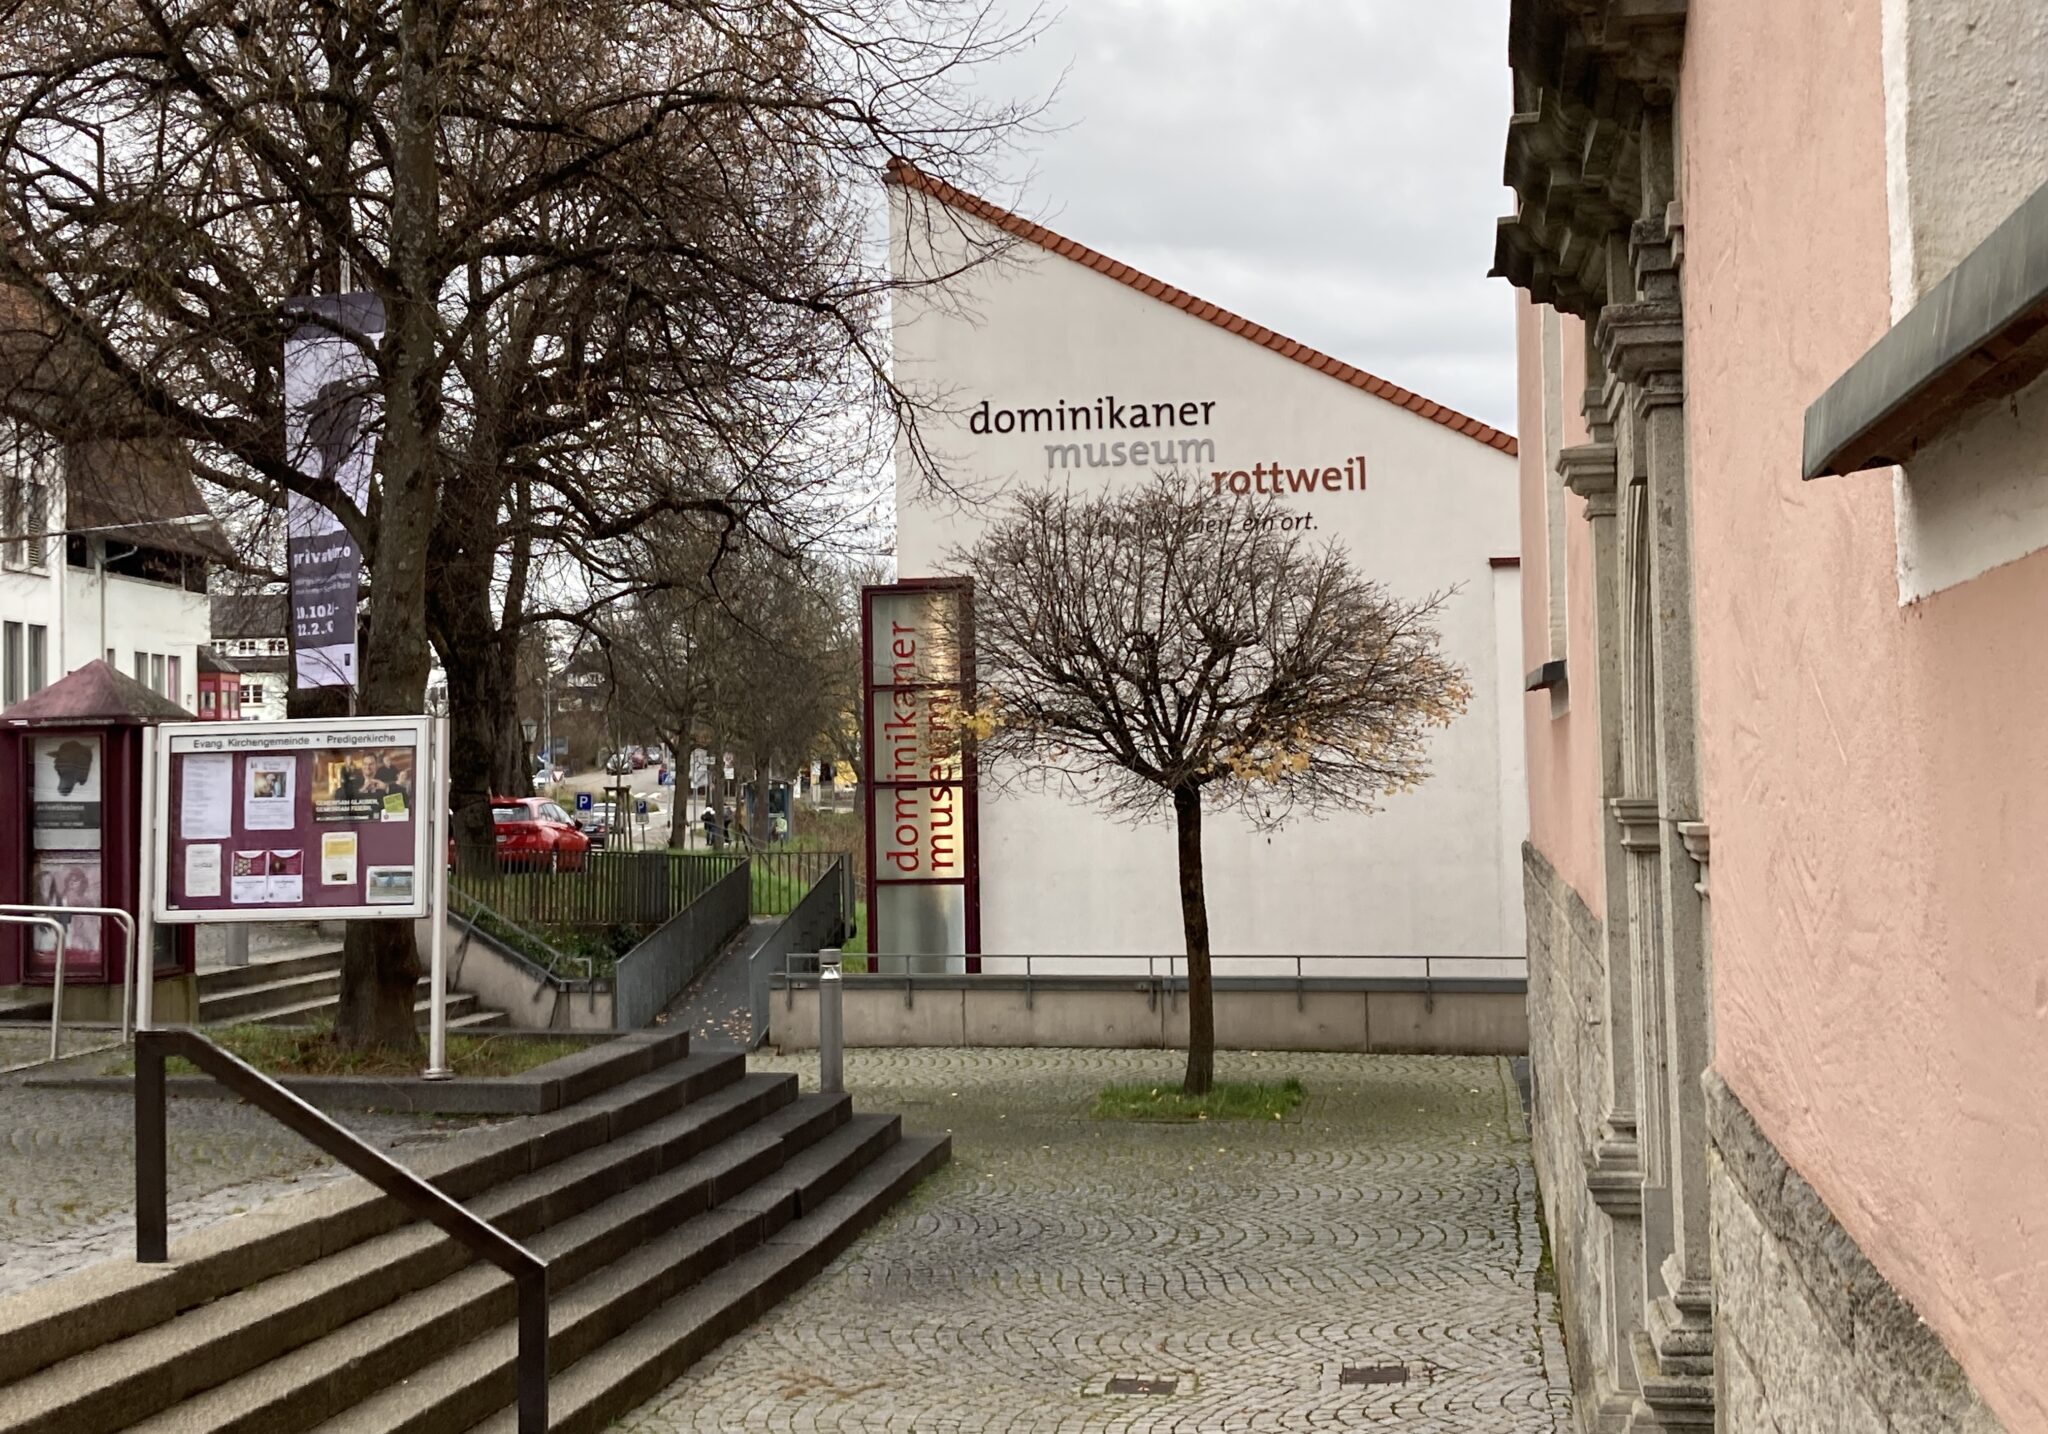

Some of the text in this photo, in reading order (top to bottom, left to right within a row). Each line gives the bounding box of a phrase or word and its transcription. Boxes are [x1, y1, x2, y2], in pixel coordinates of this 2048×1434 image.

[969, 396, 1216, 435] dominikaner
[1044, 438, 1216, 469] museum
[1211, 456, 1367, 495] rottweil
[1281, 511, 1318, 531] ort.
[228, 736, 310, 750] Kirchengemeinde
[326, 733, 396, 746] Predigerkirche
[884, 620, 918, 872] dominikaner
[927, 696, 954, 872] museum
[579, 795, 589, 809] P
